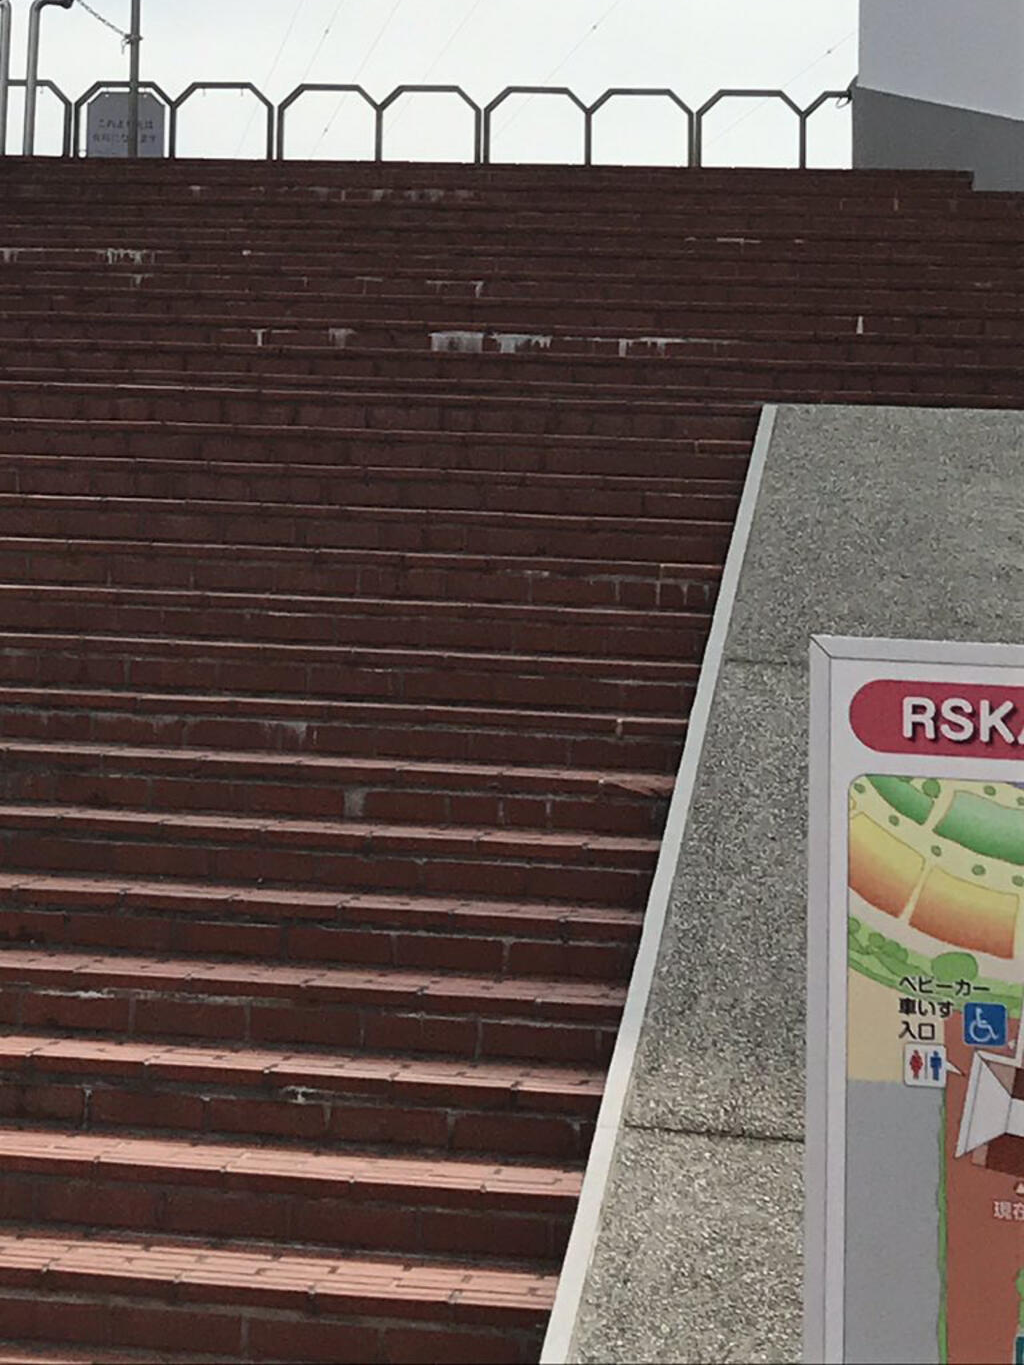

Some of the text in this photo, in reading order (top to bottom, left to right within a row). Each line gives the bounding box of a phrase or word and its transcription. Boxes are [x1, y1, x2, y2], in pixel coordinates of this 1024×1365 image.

[902, 696, 1024, 744] RSK
[899, 976, 990, 996] ベビーカー
[899, 998, 954, 1018] 車いす
[899, 1021, 935, 1040] 入口
